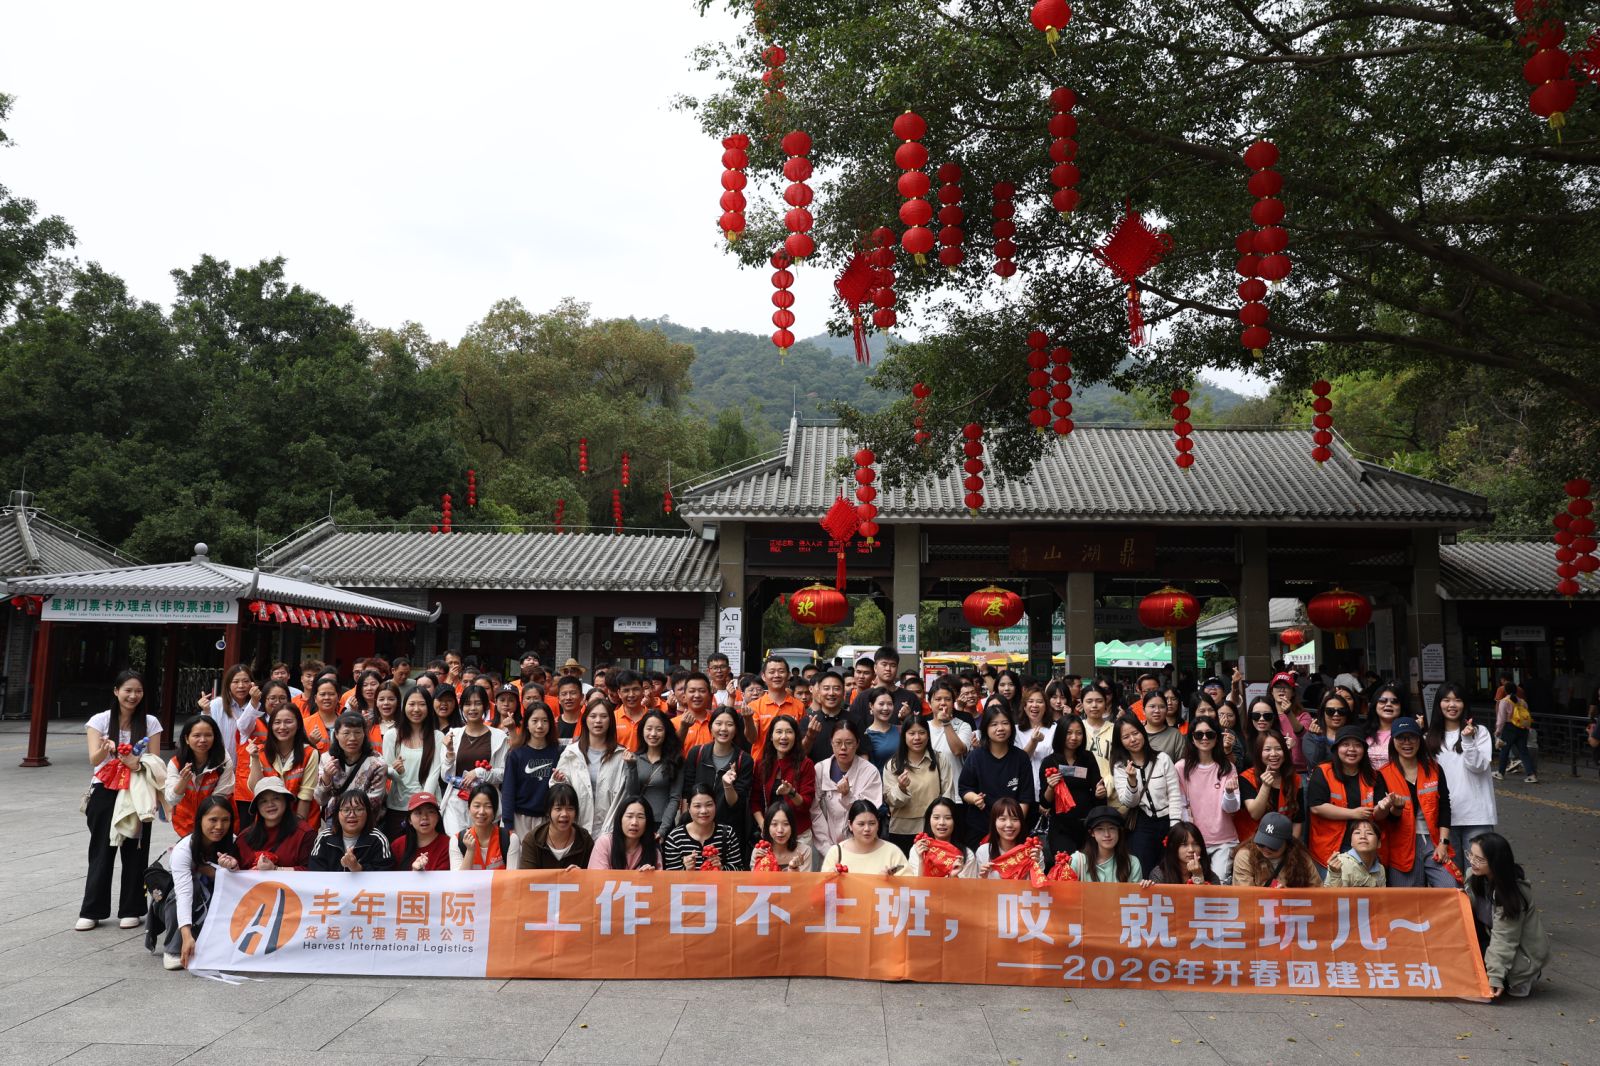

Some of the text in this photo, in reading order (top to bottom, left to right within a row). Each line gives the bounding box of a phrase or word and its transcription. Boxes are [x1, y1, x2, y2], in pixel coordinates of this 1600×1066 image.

[797, 596, 817, 617] 欢
[983, 599, 1005, 617] 度
[1172, 598, 1189, 619] 春
[1339, 600, 1360, 619] 节
[722, 613, 739, 621] 入口
[899, 623, 915, 632] 学生
[899, 634, 915, 643] 通道
[308, 888, 476, 927] 丰年国际
[305, 926, 476, 942] 货运代理有限公司
[303, 941, 475, 954] Harvest International Logistics
